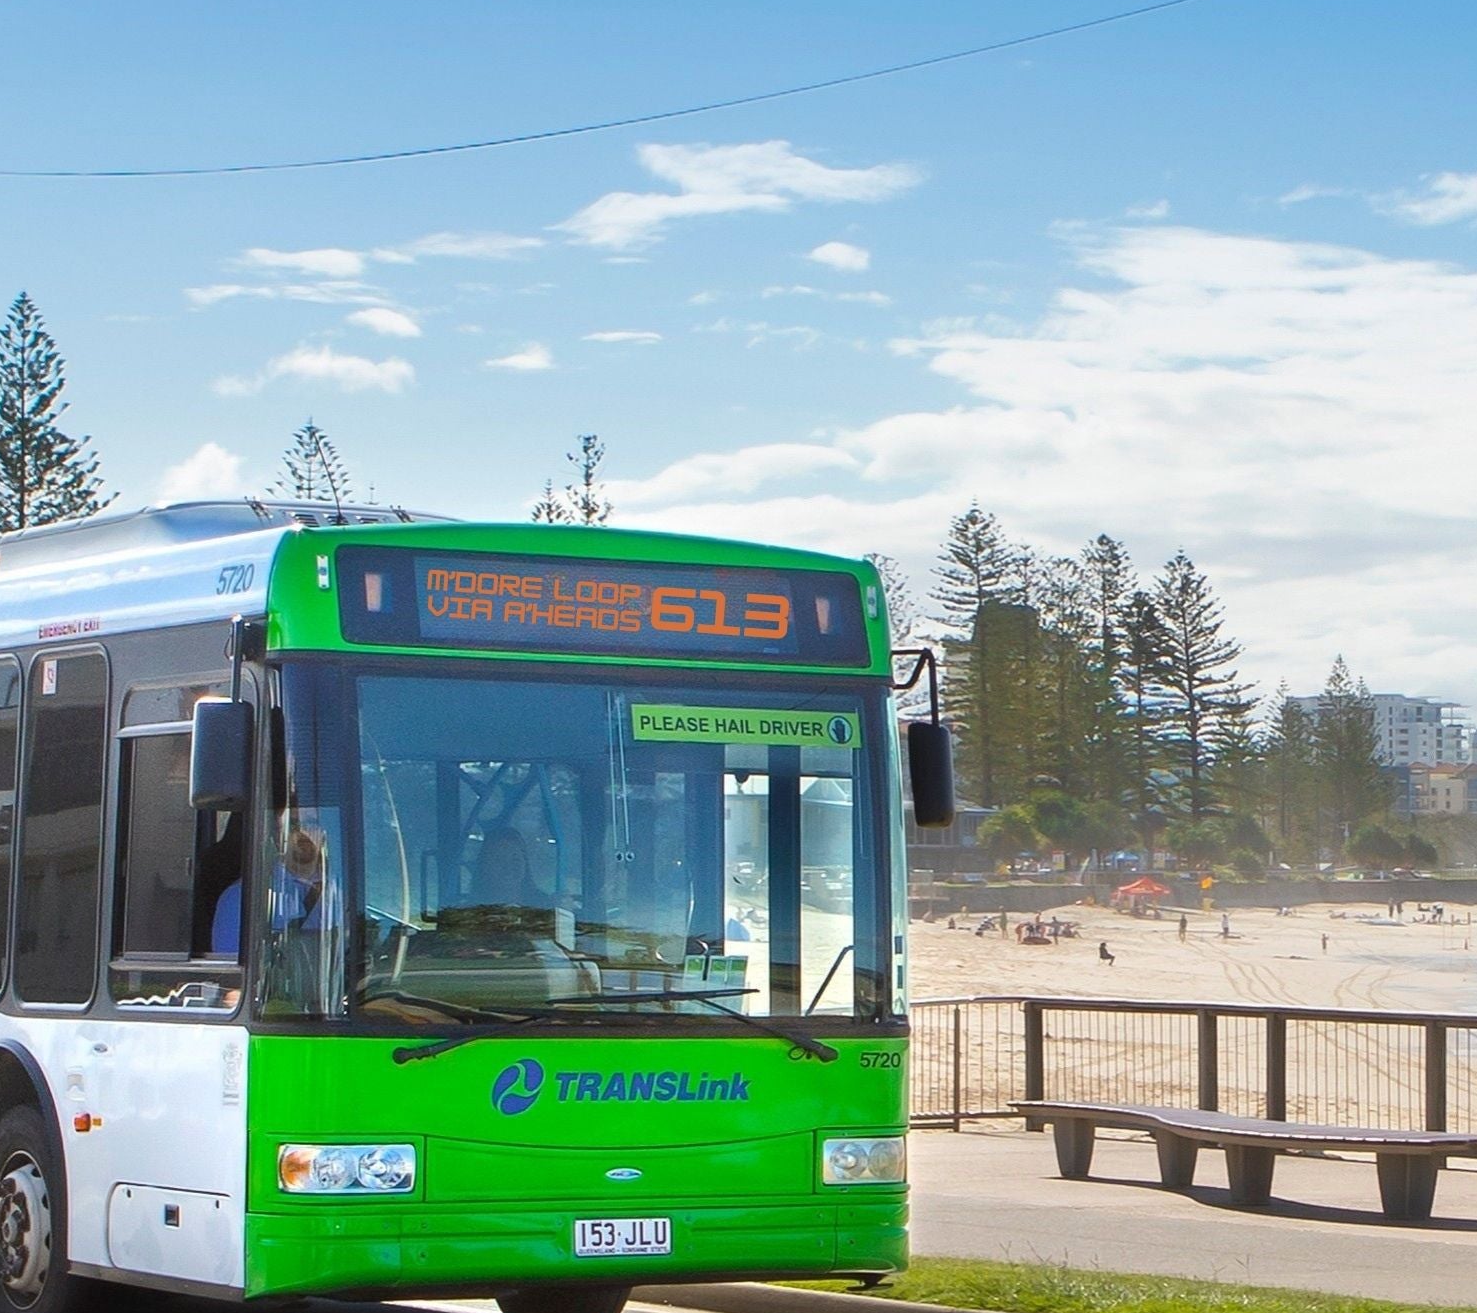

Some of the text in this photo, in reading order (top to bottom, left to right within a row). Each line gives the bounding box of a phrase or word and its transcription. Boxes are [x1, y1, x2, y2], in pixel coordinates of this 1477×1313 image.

[216, 563, 255, 595] 5720
[427, 569, 642, 605] M'DORE LOOP
[427, 594, 642, 633] VIA A'HEADS
[650, 586, 790, 640] 613
[639, 715, 824, 737] PLEASE HAIL DRIVER
[859, 1051, 902, 1069] 5720
[555, 1071, 751, 1102] TRANSLink
